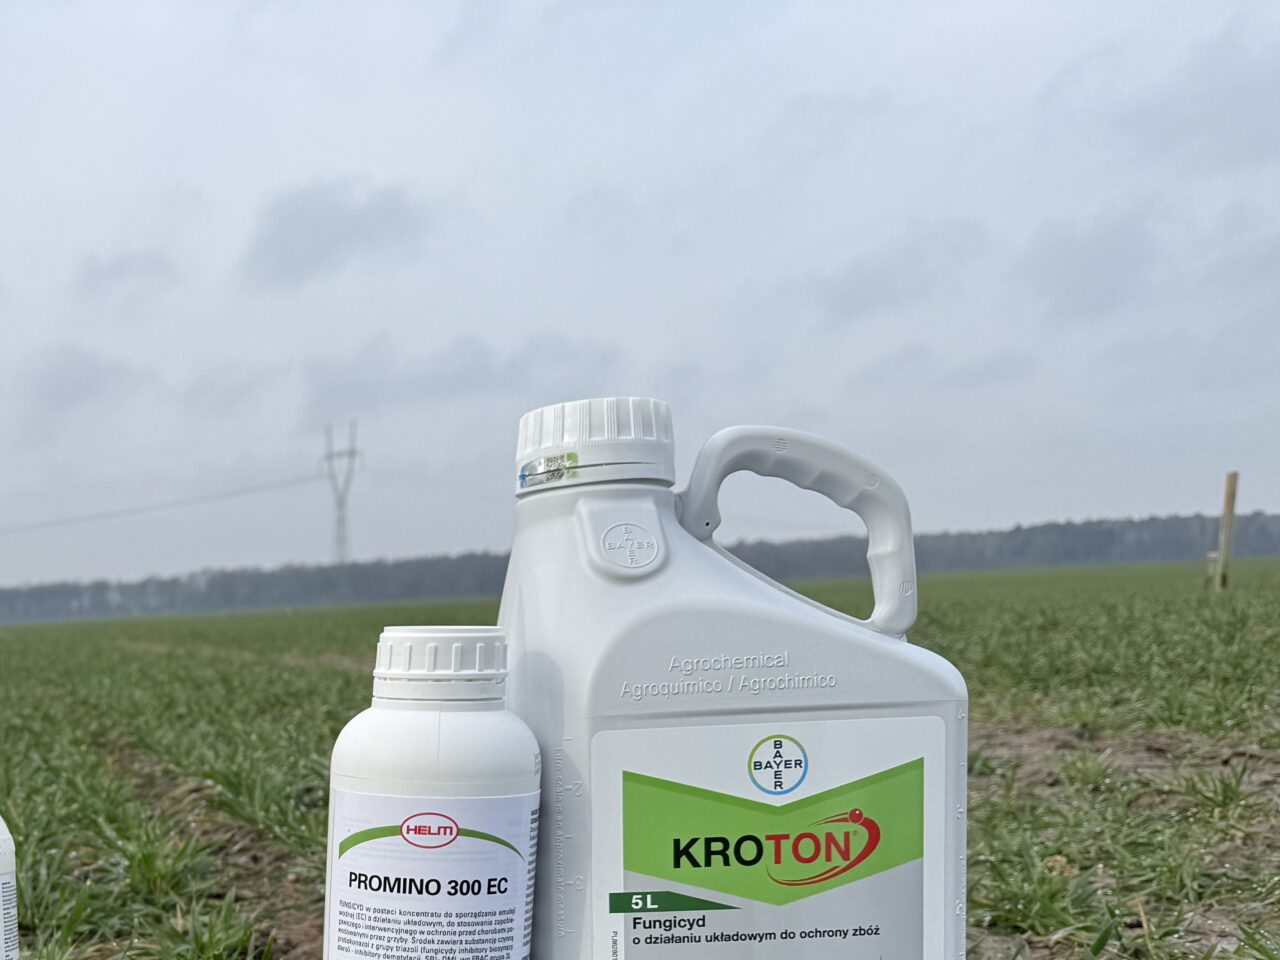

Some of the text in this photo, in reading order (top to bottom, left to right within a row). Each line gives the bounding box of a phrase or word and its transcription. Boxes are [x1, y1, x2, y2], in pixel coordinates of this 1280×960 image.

[669, 651, 789, 675] Agrochemical
[739, 673, 836, 693] Agrochimico
[753, 759, 804, 771] BAYER
[773, 740, 784, 790] BAYER
[406, 825, 453, 836] HELM
[349, 872, 509, 896] PROMINO 300 EC
[355, 912, 367, 921] (EC)
[457, 919, 492, 927] stosowania
[373, 907, 397, 915] postaci
[399, 909, 442, 918] koncentratu
[365, 924, 417, 936] interwencyjnego
[458, 929, 476, 937] przed
[632, 915, 706, 932] Fungicyd
[370, 933, 386, 942] przez
[411, 936, 437, 945] Środek
[632, 925, 881, 946] o działaniu układowym do ochrony zbóż
[376, 943, 395, 952] grupy
[396, 945, 419, 953] triazoli
[421, 947, 457, 956] (fungicydy
[458, 945, 488, 955] inhibitory
